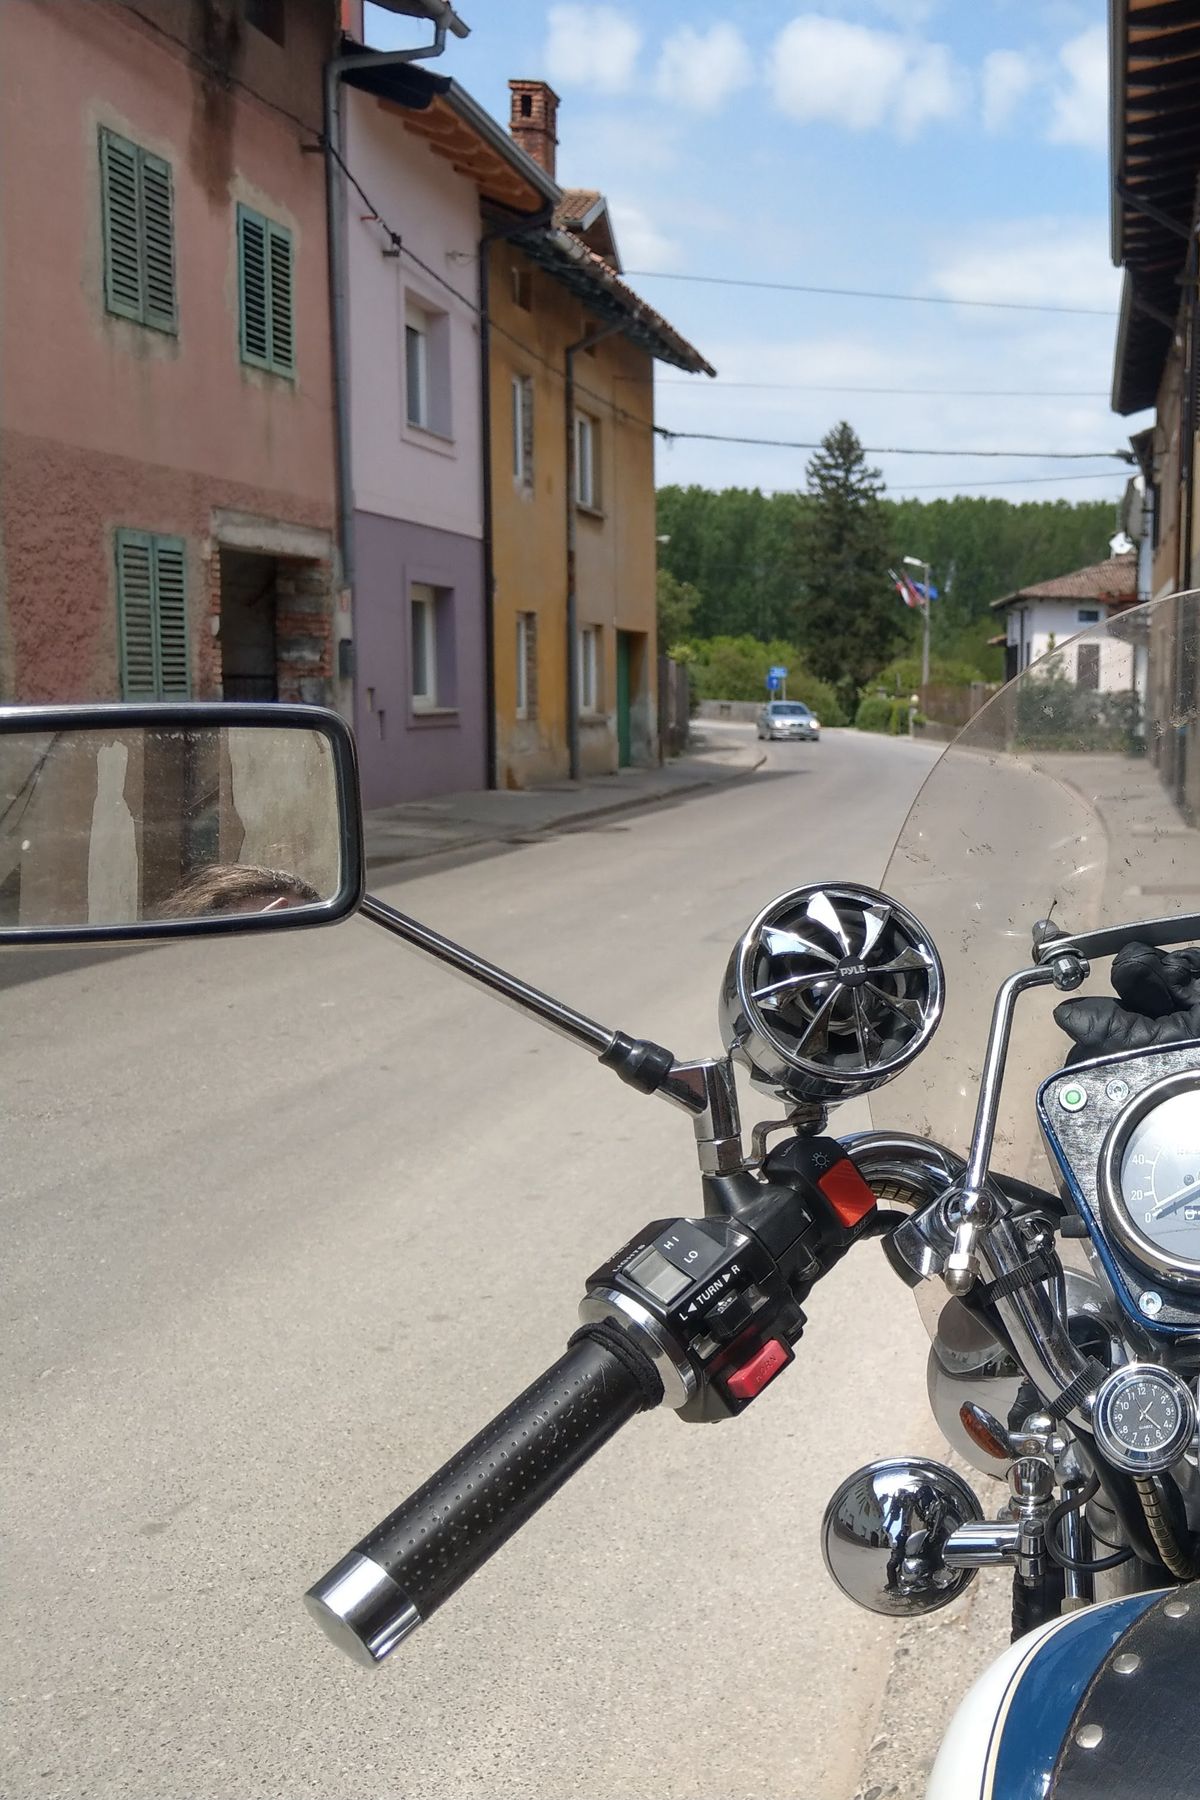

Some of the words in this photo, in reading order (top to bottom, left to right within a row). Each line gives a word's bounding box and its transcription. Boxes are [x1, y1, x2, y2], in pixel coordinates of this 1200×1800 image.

[839, 964, 866, 977] PYLE
[1132, 1154, 1145, 1165] 40
[1131, 1190, 1143, 1201] 20
[1144, 1212, 1151, 1224] 0
[663, 1234, 680, 1250] HI
[683, 1250, 698, 1264] LO
[678, 1311, 689, 1321] L
[696, 1279, 724, 1306] TURN
[730, 1264, 741, 1275] R
[1127, 1392, 1135, 1400] 11
[1137, 1387, 1146, 1396] 12
[1160, 1396, 1166, 1404] 2
[1121, 1401, 1129, 1410] 10
[1166, 1407, 1171, 1415] 3
[1118, 1413, 1123, 1422] 9
[1163, 1420, 1168, 1428] 4
[1122, 1425, 1128, 1433] 8
[1132, 1432, 1137, 1440] 7
[1144, 1434, 1150, 1442] 6
